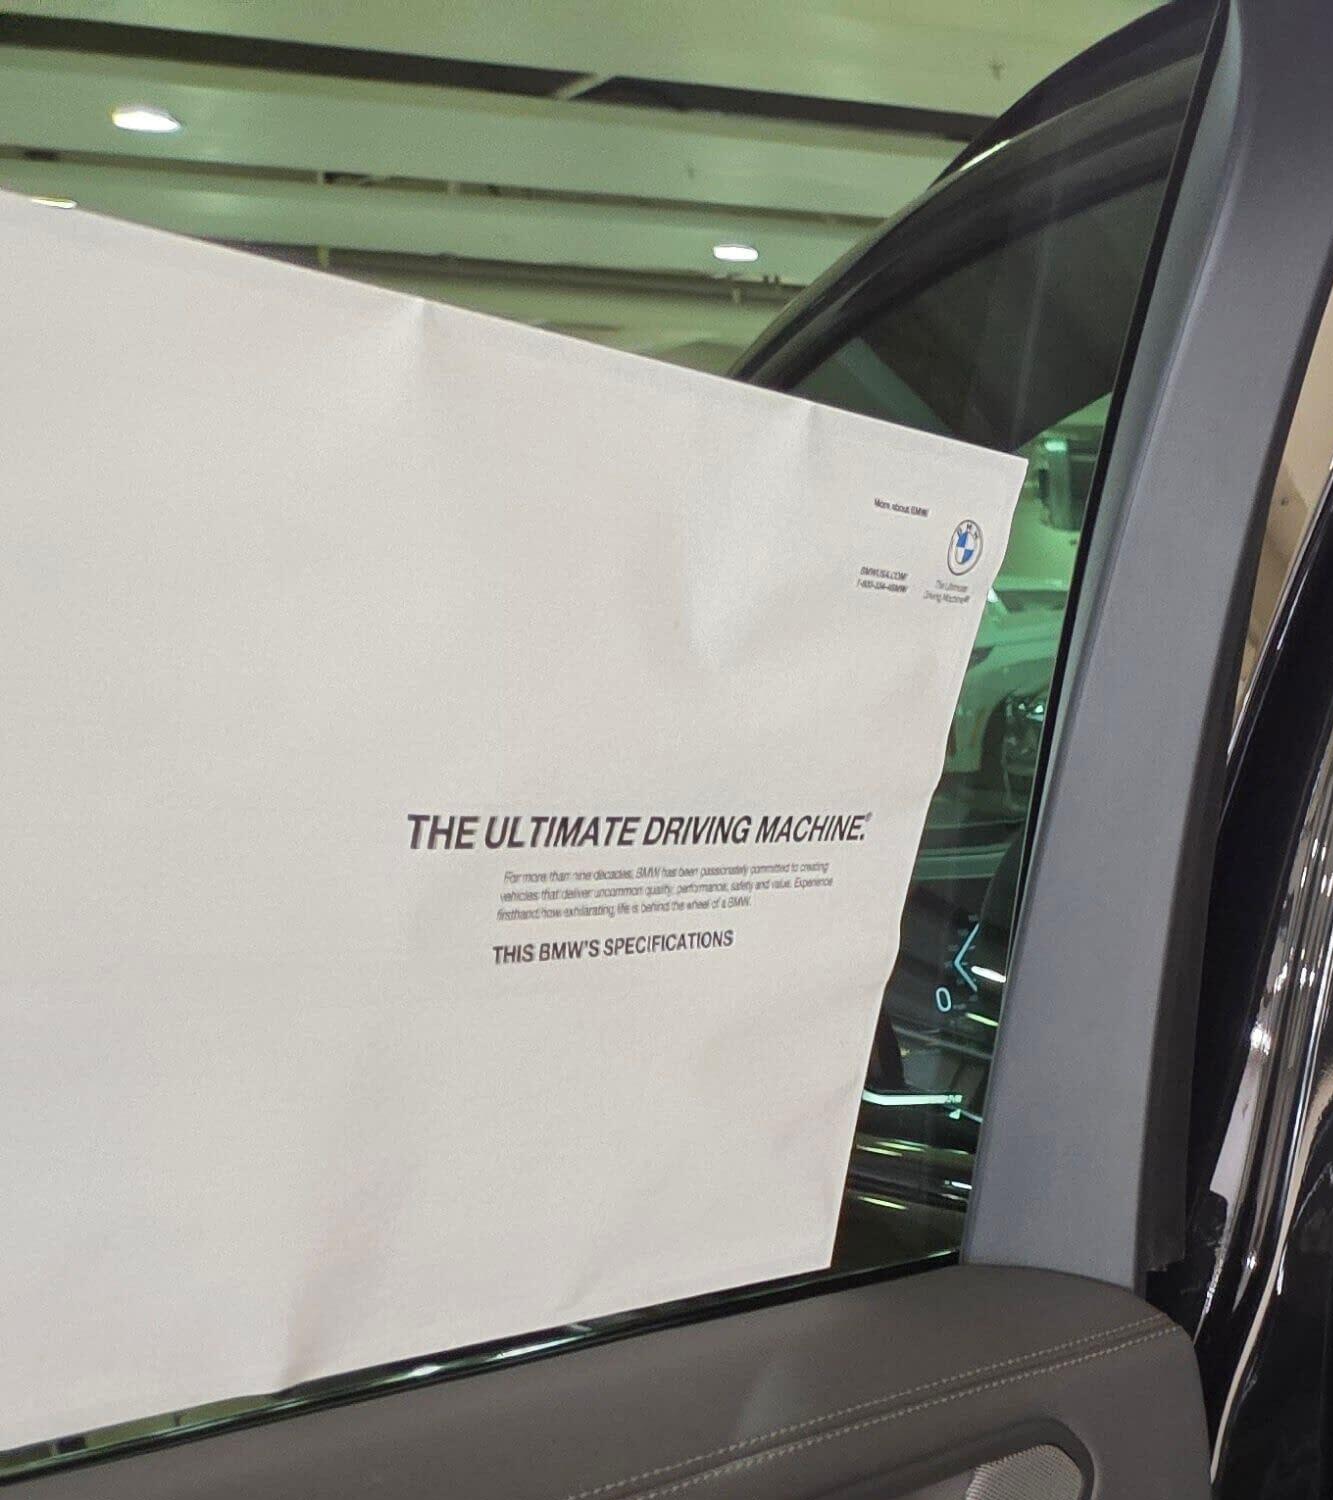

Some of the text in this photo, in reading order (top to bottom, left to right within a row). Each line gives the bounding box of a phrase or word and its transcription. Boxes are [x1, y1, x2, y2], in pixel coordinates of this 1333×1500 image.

[407, 814, 479, 850] THE
[484, 816, 640, 850] ULTIMATE
[642, 815, 752, 845] DRIVING
[635, 866, 661, 879] BMW
[492, 929, 734, 965] THIS BMW'S SPECIFICATIONS
